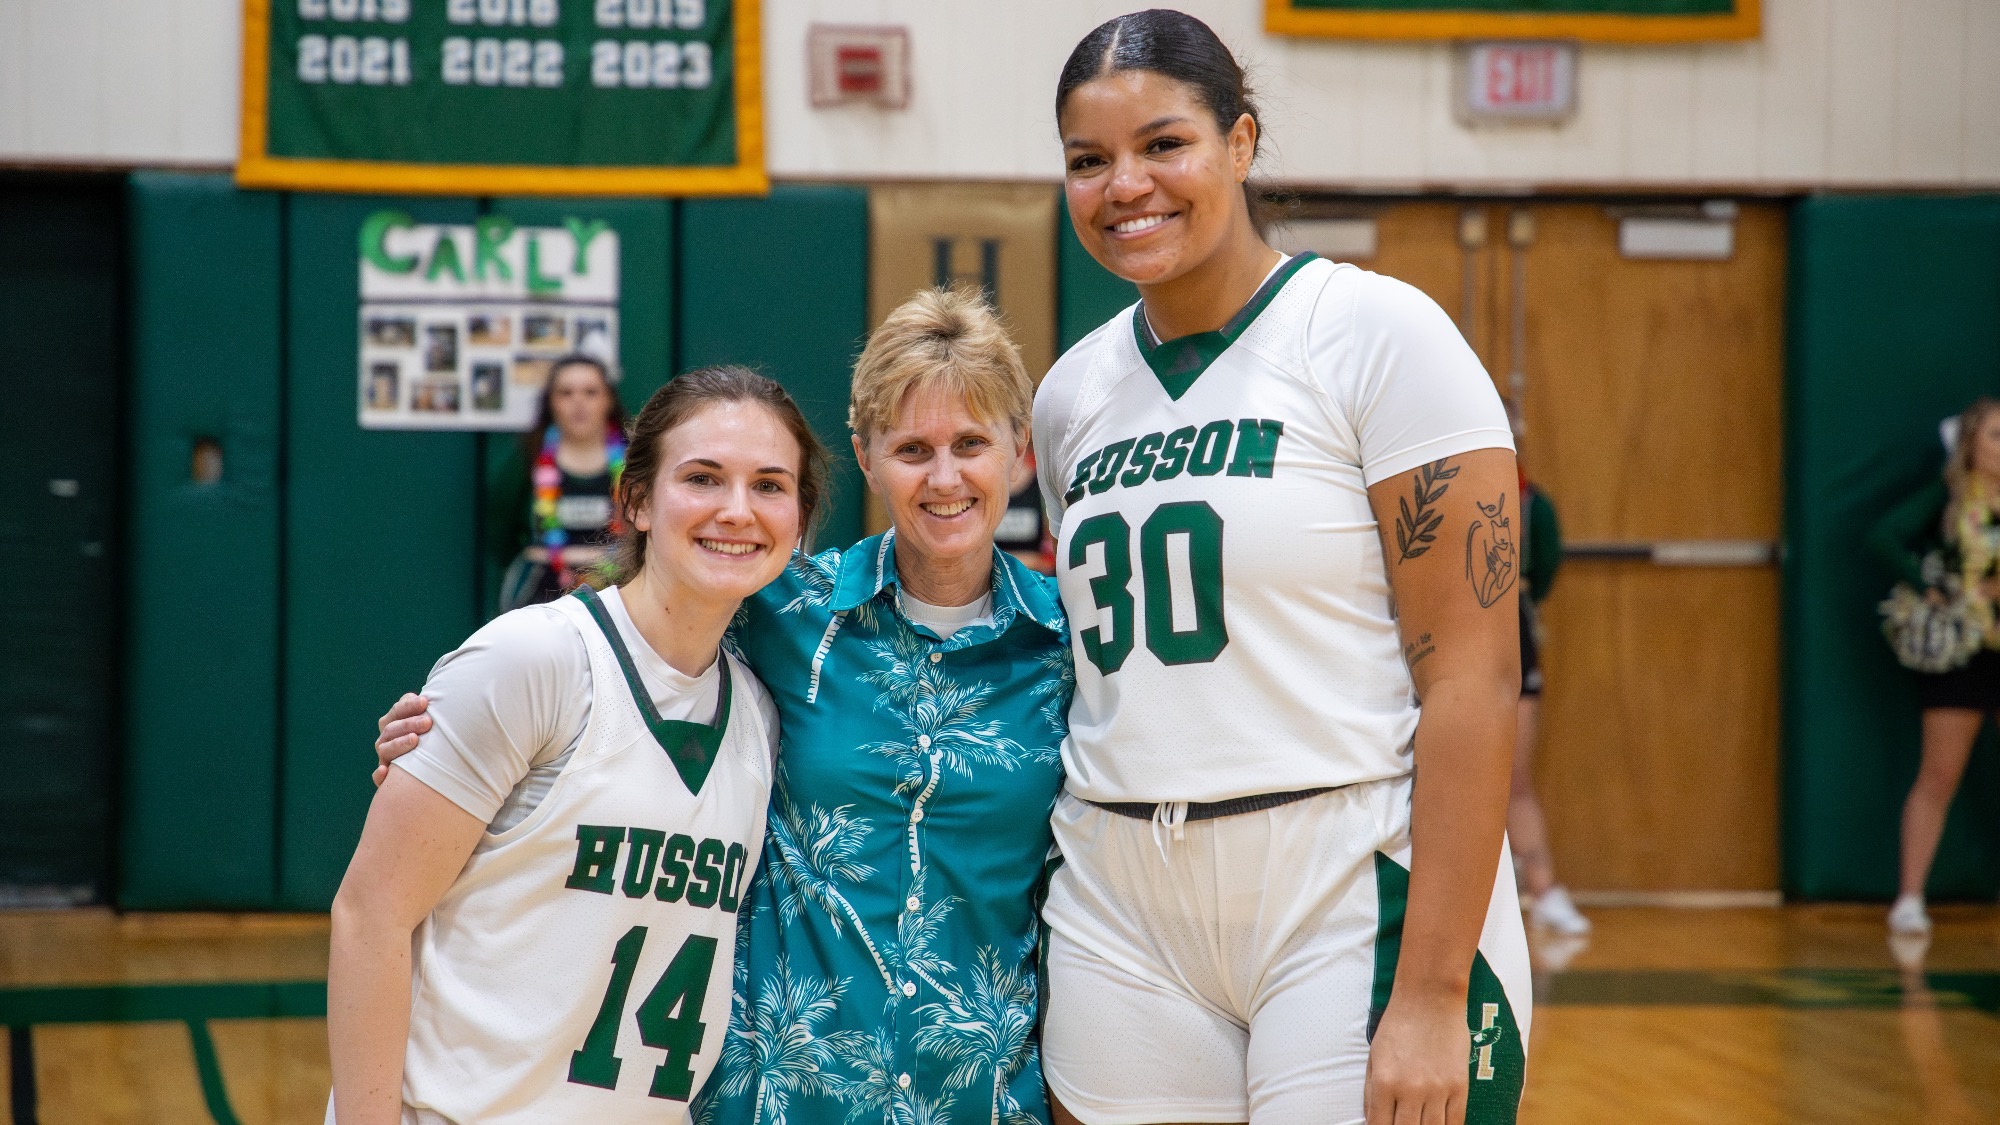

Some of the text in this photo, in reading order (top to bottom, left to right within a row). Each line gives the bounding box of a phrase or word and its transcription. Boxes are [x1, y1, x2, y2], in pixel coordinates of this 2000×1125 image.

[298, 35, 712, 88] 2021 2022 2023
[1487, 47, 1557, 105] EXIT
[359, 210, 609, 293] CARLY
[1069, 500, 1230, 677] 30
[565, 824, 748, 914] HUSSO
[567, 925, 718, 1103] 14
